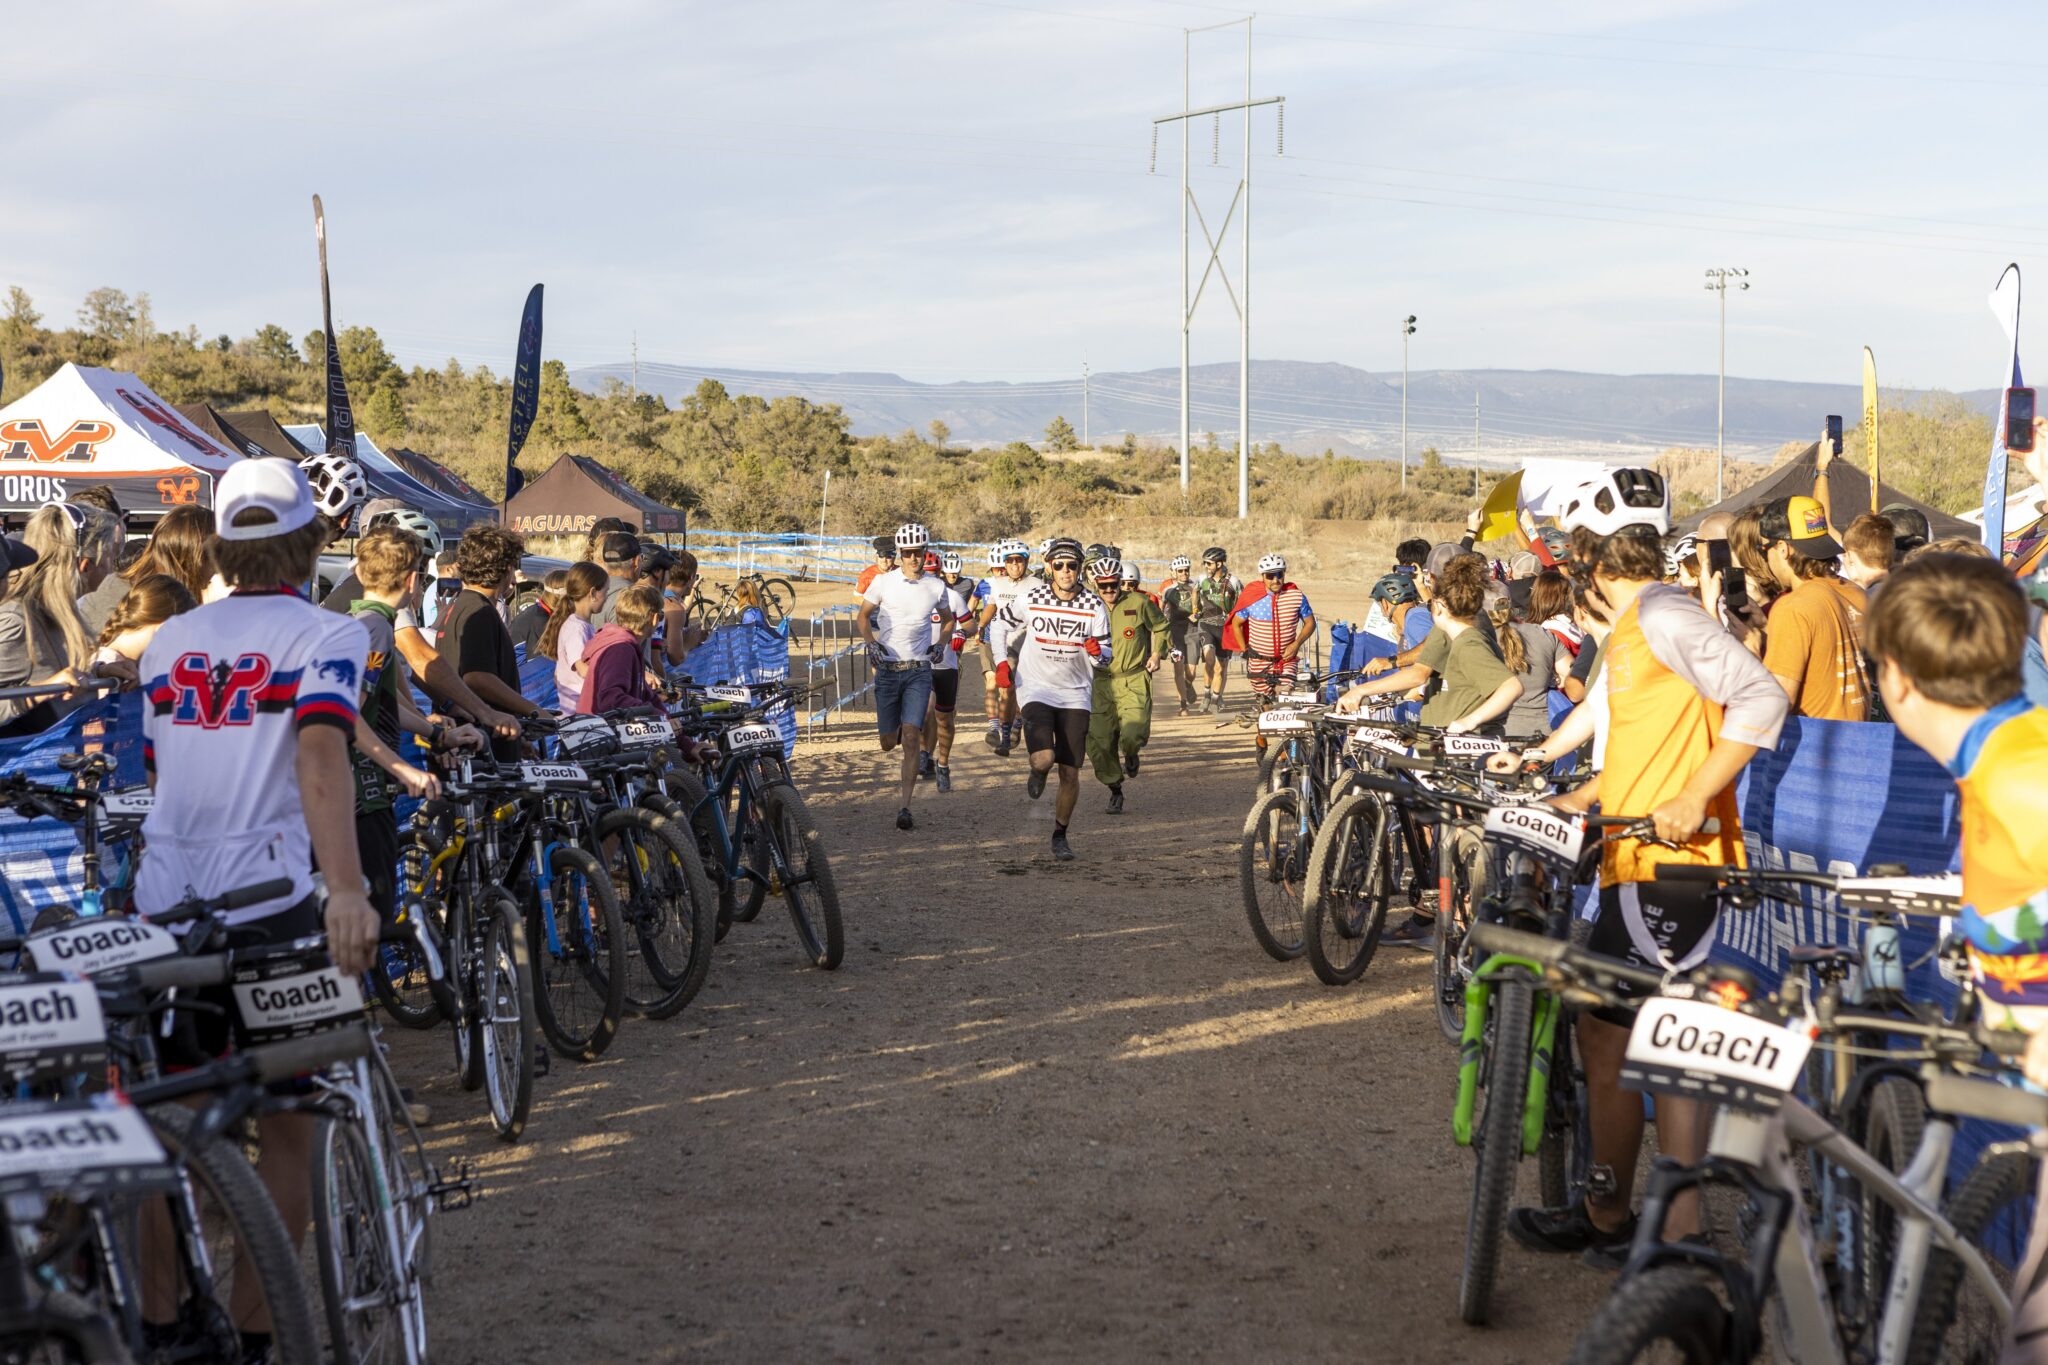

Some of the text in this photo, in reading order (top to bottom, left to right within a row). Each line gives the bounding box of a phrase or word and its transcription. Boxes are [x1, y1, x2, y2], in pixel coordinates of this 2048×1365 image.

[511, 514, 597, 533] JAGUARS
[711, 687, 745, 697] Coach
[625, 723, 666, 737] Coach
[733, 727, 776, 743] Coach
[1452, 739, 1501, 751] Coach
[531, 766, 579, 778] Coach
[1501, 810, 1569, 845] Coach
[50, 924, 153, 960] Coach
[250, 973, 341, 1012] Coach
[0, 989, 78, 1027] ach
[1651, 1013, 1780, 1070] Coach
